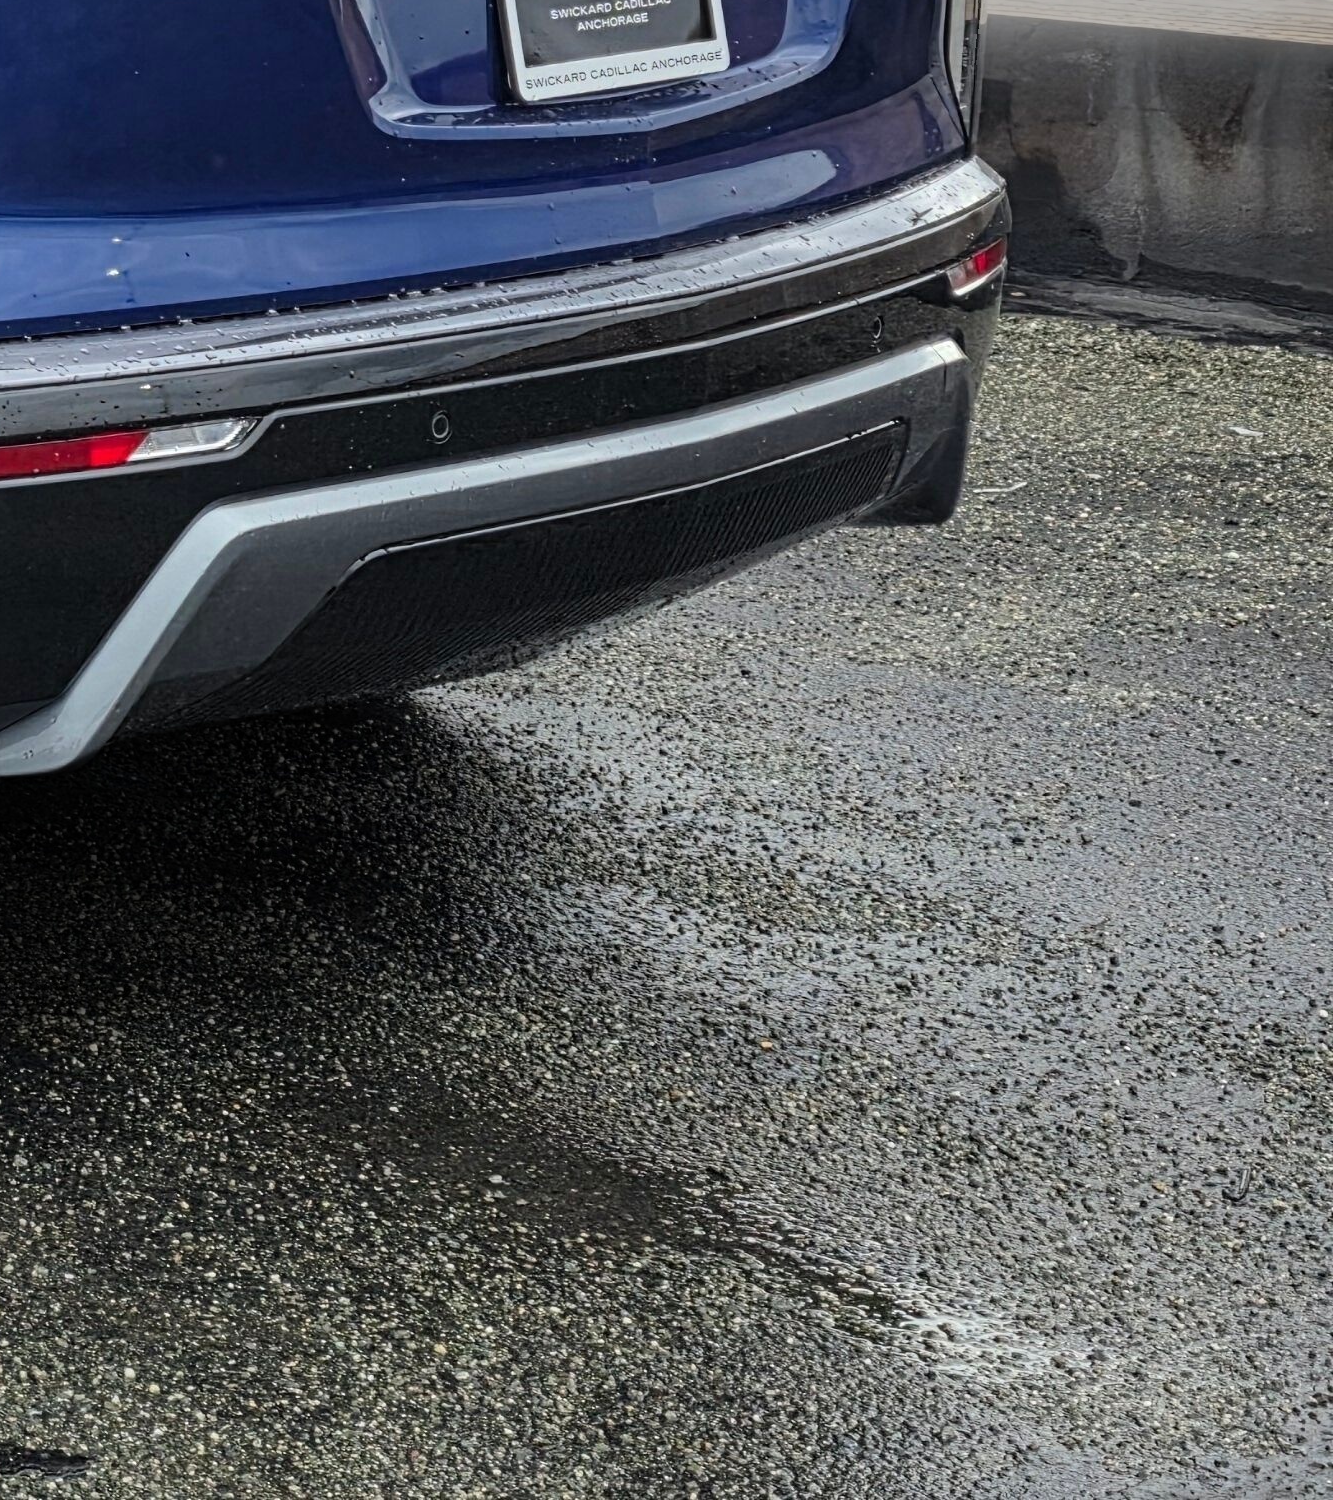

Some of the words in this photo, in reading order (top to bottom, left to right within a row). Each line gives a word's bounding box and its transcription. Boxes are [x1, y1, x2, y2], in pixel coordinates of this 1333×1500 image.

[549, 2, 612, 20] SWICKARD
[576, 12, 649, 32] ANCHORAGE
[525, 71, 587, 90] SWICKARD
[590, 62, 648, 80] CADILLAC
[651, 50, 723, 71] ANCHORAGE
